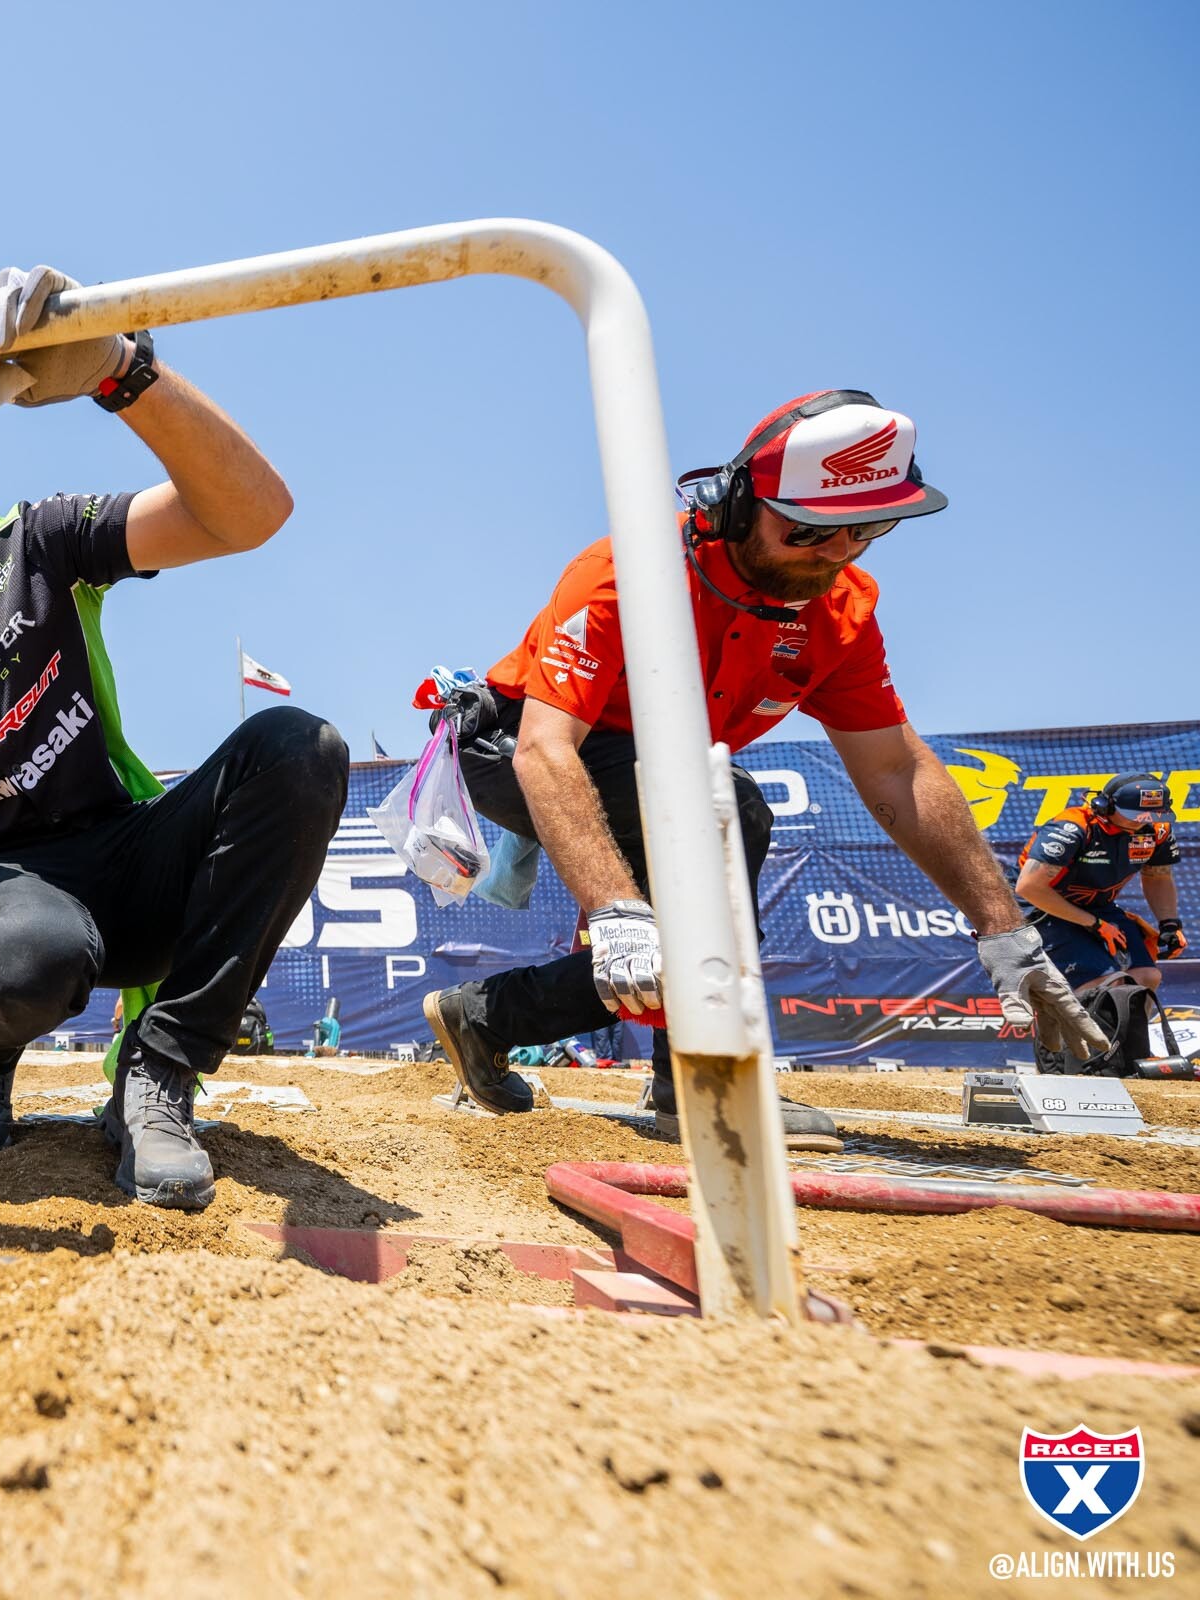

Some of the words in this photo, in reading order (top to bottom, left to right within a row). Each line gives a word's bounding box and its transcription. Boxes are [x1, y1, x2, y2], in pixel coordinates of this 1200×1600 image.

[820, 466, 900, 489] HONDA
[778, 621, 808, 631] NDA
[578, 657, 599, 670] DID
[597, 922, 650, 942] Mechanix
[779, 997, 1003, 1016] INTENS
[899, 1016, 1006, 1031] TAZER
[400, 1053, 413, 1062] 28
[1042, 1098, 1067, 1111] 88
[1079, 1103, 1135, 1112] FARRES
